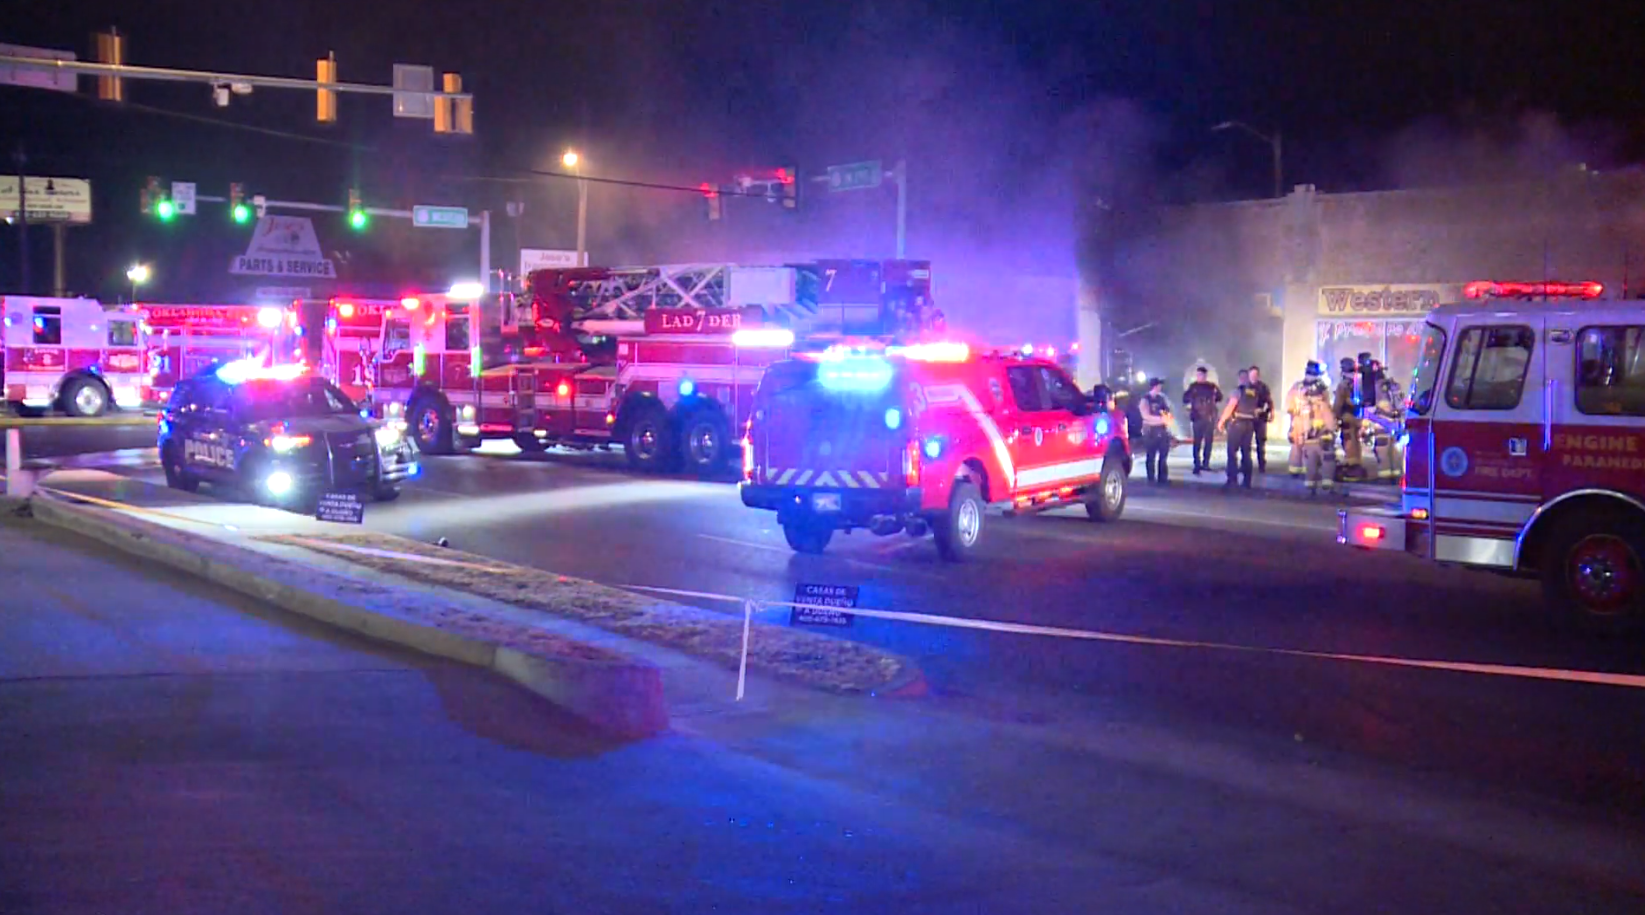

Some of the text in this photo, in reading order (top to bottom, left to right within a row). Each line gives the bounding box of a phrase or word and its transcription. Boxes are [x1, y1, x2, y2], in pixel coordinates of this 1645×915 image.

[239, 257, 274, 273] PARTS
[287, 260, 330, 275] SERVICE
[825, 269, 837, 292] 7
[1322, 286, 1440, 311] Western
[662, 314, 694, 328] LAD
[696, 310, 706, 331] 7
[185, 439, 235, 469] POLICE
[1553, 434, 1638, 452] ENGINE
